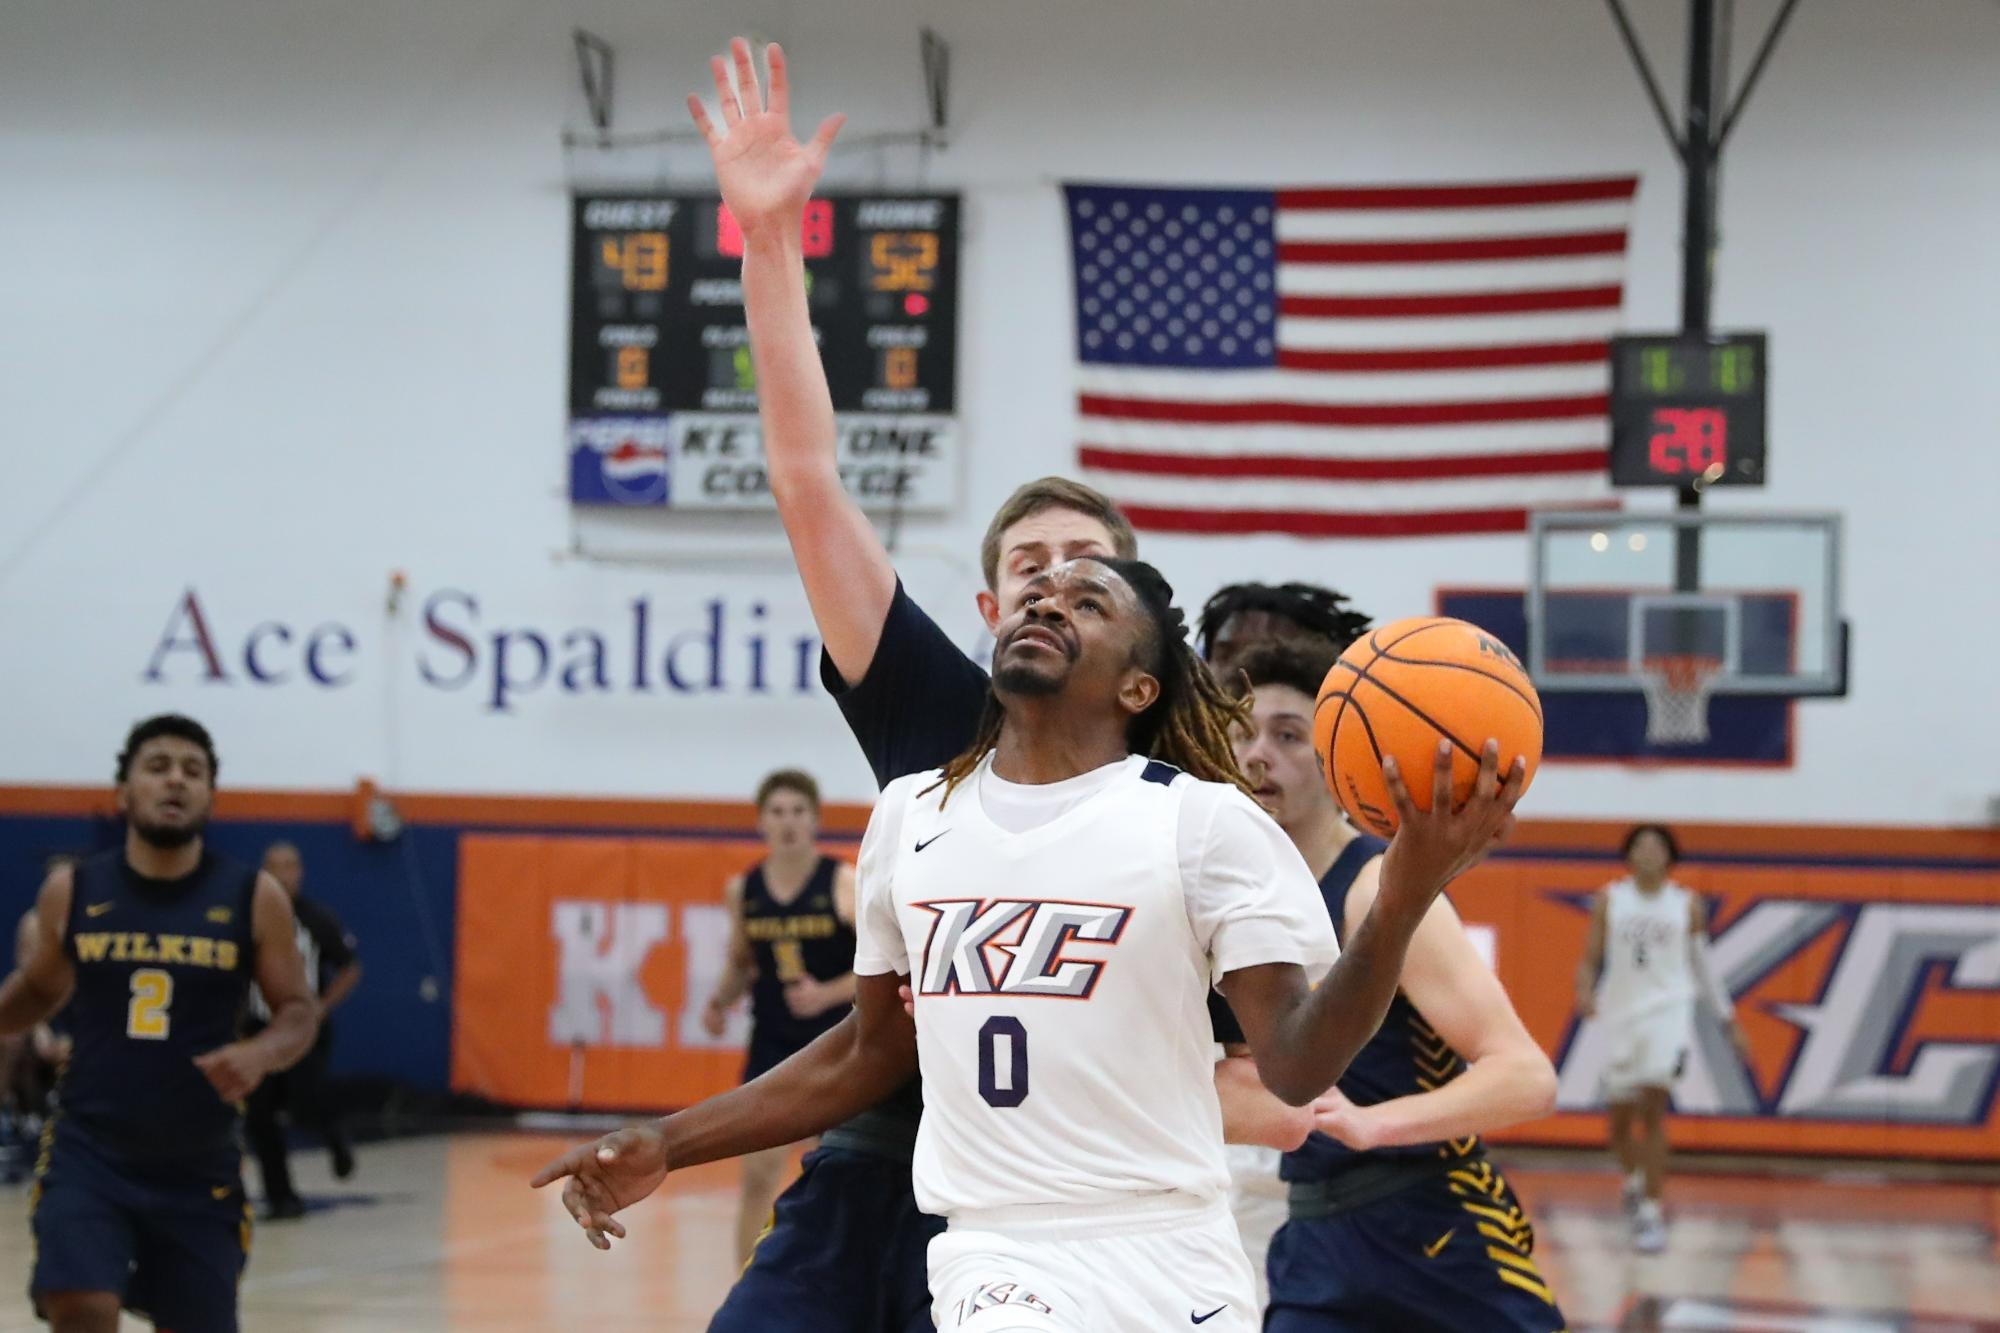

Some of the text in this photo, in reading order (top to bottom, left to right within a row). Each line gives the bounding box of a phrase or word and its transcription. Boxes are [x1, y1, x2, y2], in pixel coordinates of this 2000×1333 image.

[871, 232, 940, 292] 52
[681, 425, 944, 458] KEONE
[142, 588, 356, 688] Ace
[75, 932, 239, 970] WILKES
[908, 897, 1136, 1001] KC
[127, 967, 174, 1041] 2
[979, 1016, 1029, 1107] 0
